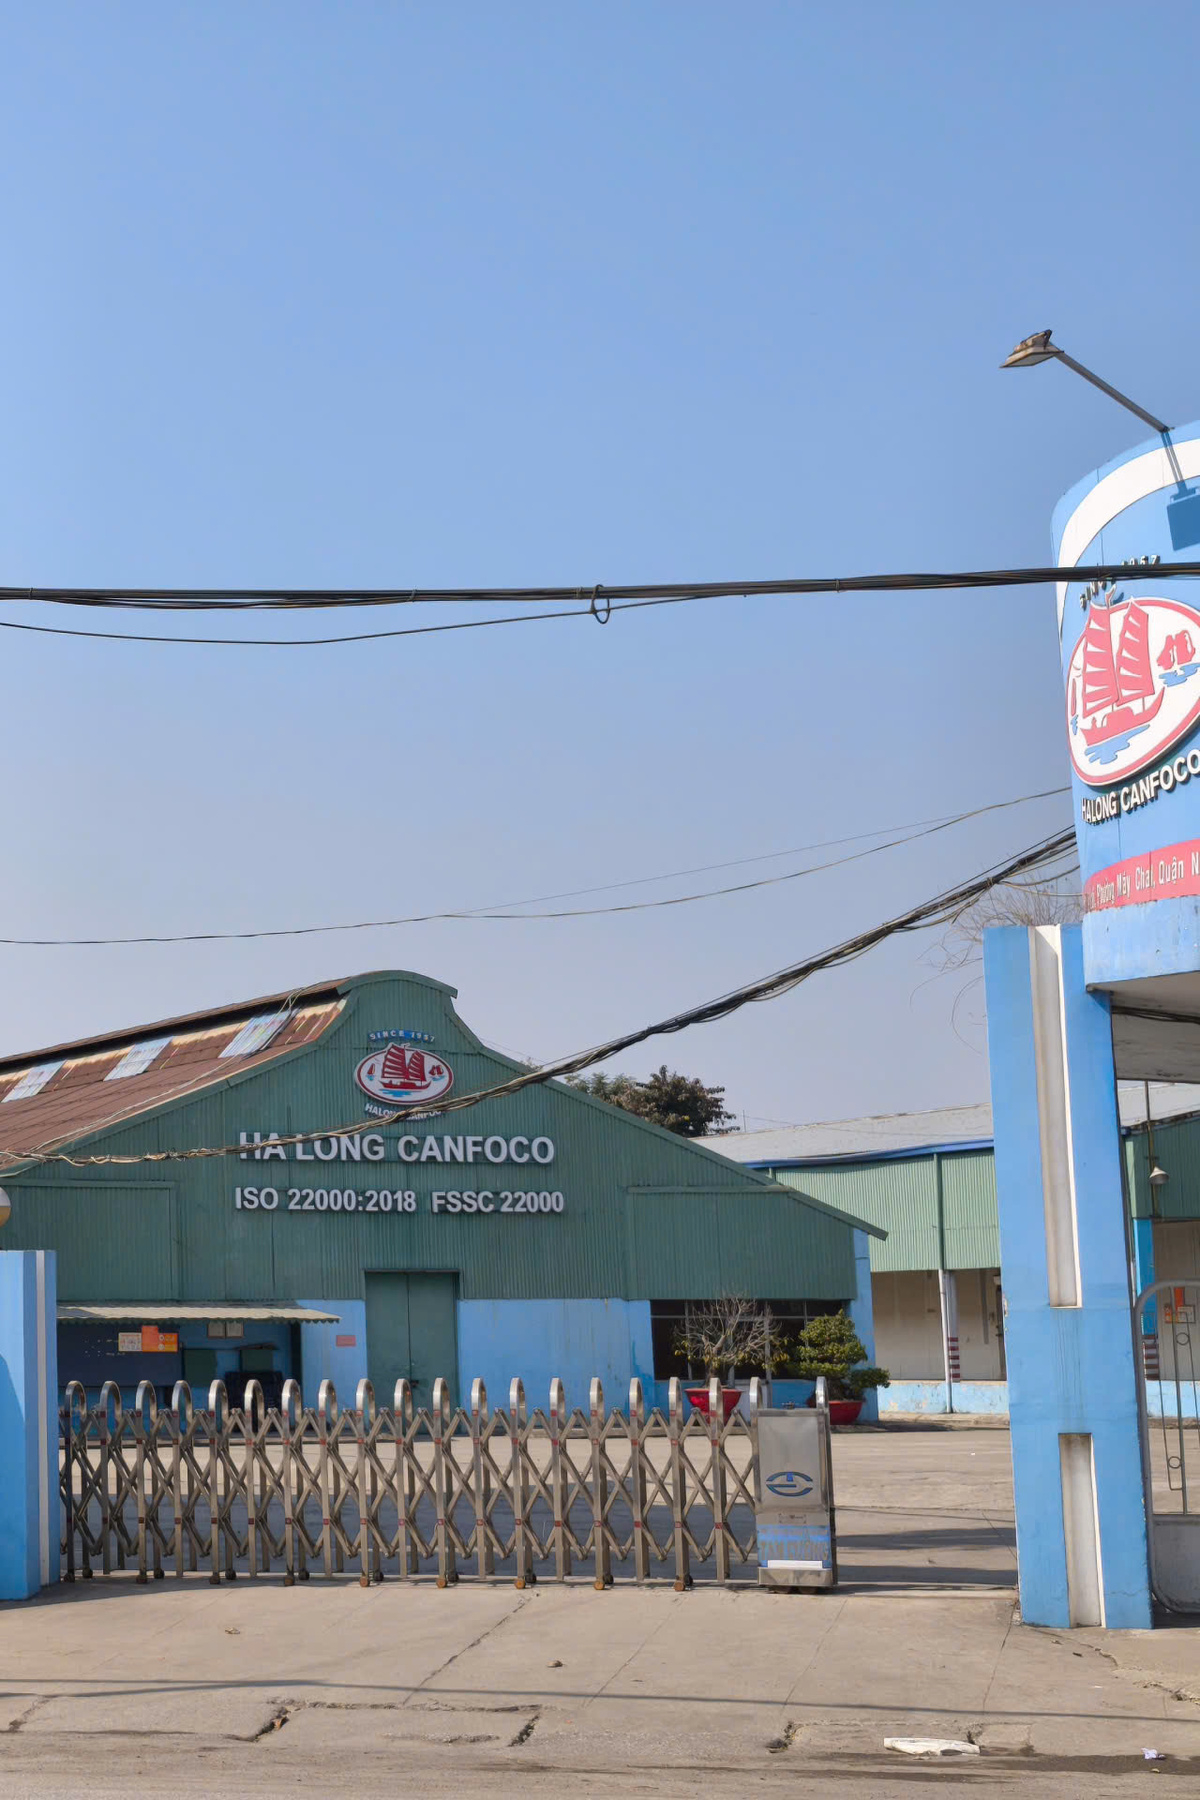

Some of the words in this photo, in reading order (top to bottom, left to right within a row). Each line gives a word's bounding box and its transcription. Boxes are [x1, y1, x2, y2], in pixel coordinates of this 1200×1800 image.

[1081, 791, 1117, 823] HALONG
[1120, 749, 1200, 811] CANFOCO
[1159, 856, 1184, 884] Quận
[369, 1030, 405, 1040] SINCE
[239, 1132, 287, 1160] HA
[295, 1134, 385, 1161] LONG
[397, 1135, 555, 1164] CANFOCO
[235, 1187, 279, 1210] ISO
[287, 1188, 417, 1212] 22000:2018
[431, 1190, 495, 1213] FSSC
[500, 1191, 564, 1213] 22000
